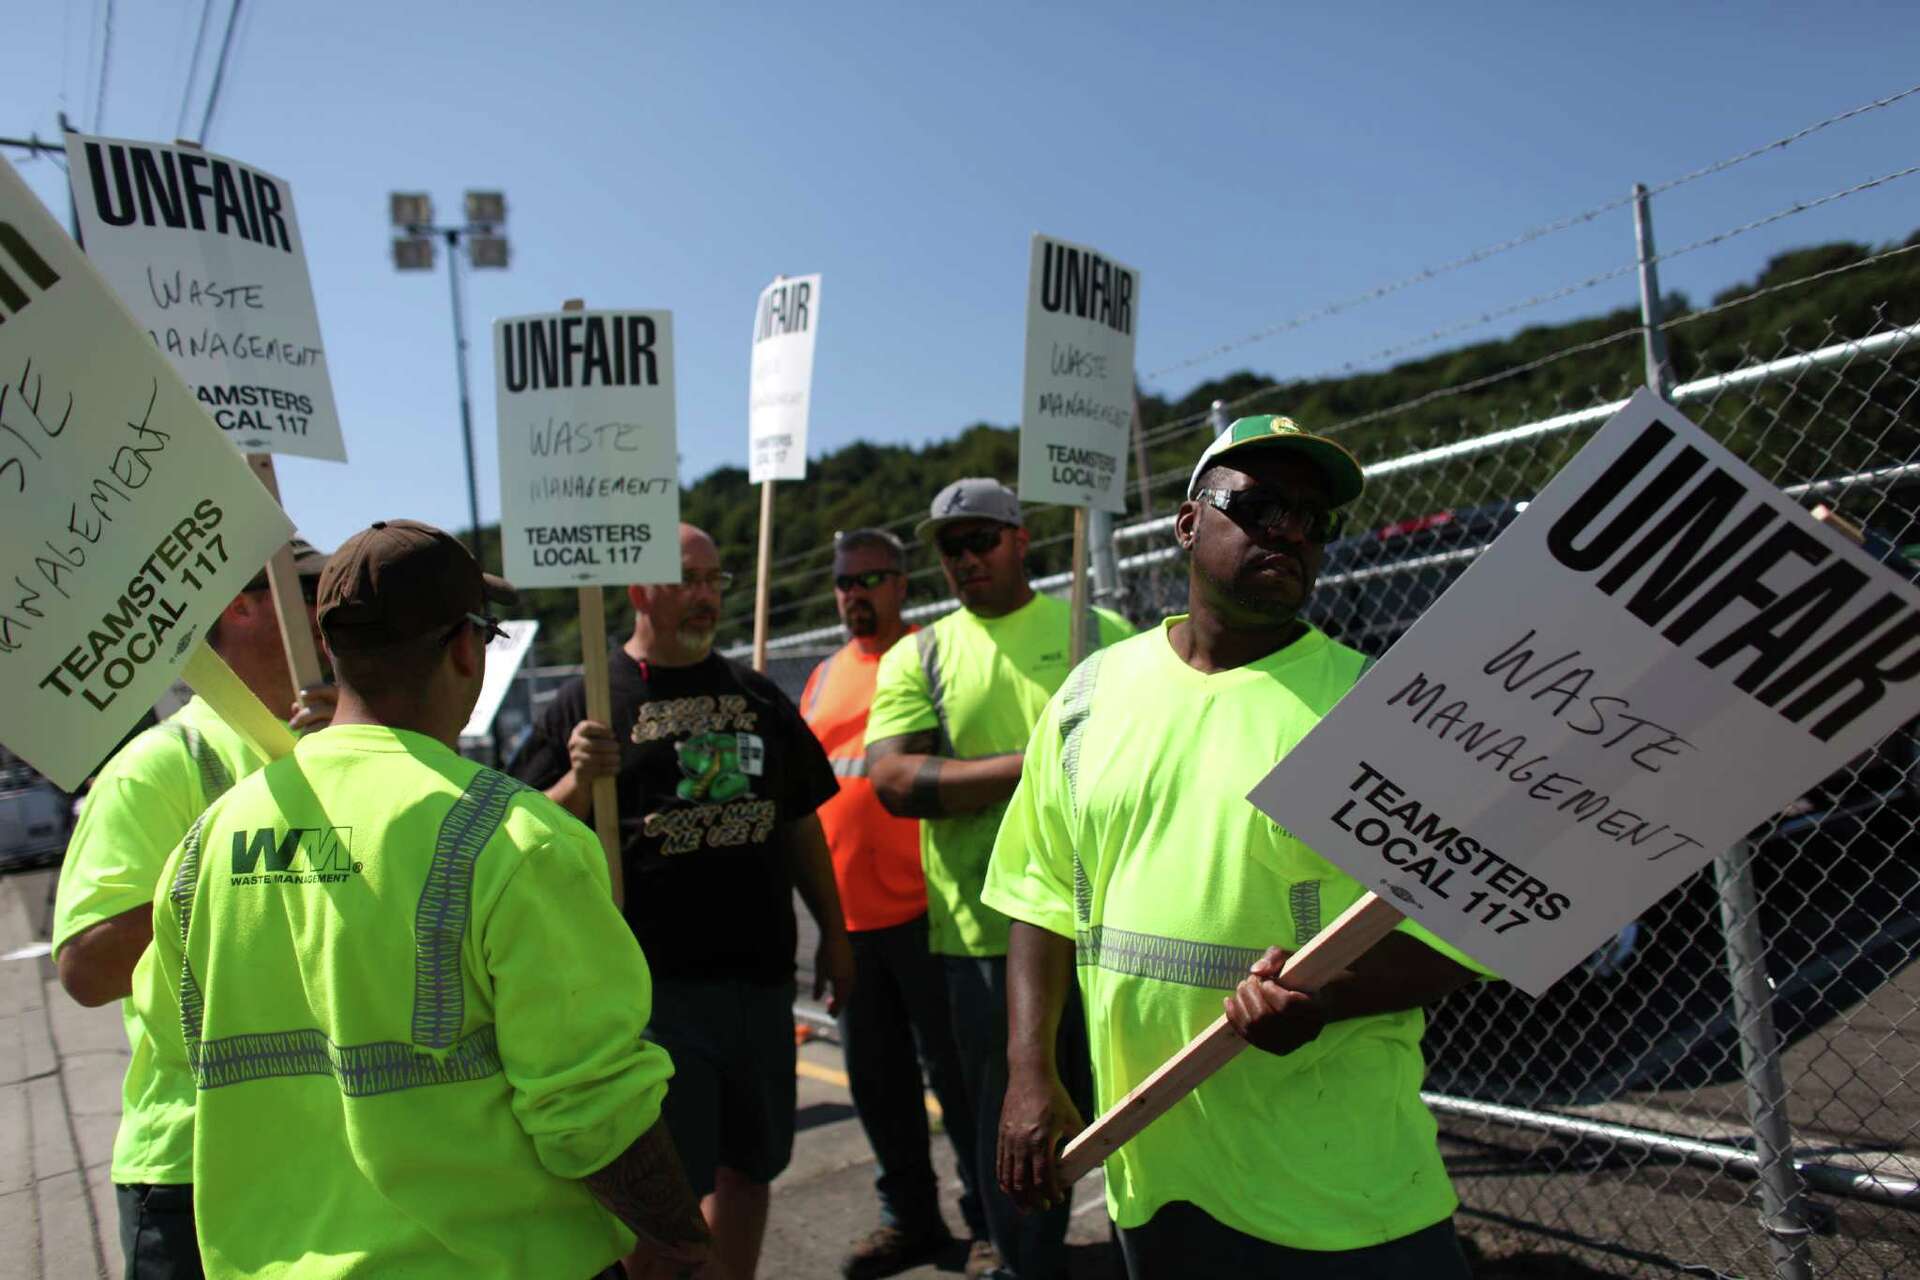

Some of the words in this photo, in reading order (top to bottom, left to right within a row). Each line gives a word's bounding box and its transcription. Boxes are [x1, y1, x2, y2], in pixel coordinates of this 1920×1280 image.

[84, 142, 292, 253] UNFAIR
[148, 266, 264, 310] WASTE
[1042, 242, 1133, 335] UNFAIR
[503, 316, 658, 392] UNFAIR
[1051, 342, 1108, 379] WASTE
[197, 385, 313, 415] AMSTERS
[215, 410, 272, 431] CAL
[276, 414, 309, 436] 117
[529, 417, 642, 457] WASTE
[1046, 444, 1117, 475] TEAMSTERS
[530, 475, 671, 503] MANAGEMENT
[1052, 466, 1096, 489] LOCAL
[0, 377, 170, 653] ANAGEMENT
[525, 524, 651, 545] TEAMSTERS
[533, 547, 600, 567] LOCAL
[609, 546, 642, 564] 117
[38, 499, 224, 697] TEAMSTERS
[1546, 418, 1920, 743] UNFAIR
[81, 597, 188, 712] LOCAL
[181, 534, 229, 591] 117
[1483, 629, 1702, 773] WASTE
[1387, 672, 1704, 862] MANAGEMENT
[232, 827, 352, 874] WM
[1347, 761, 1571, 922] TEAMSTERS
[231, 875, 272, 886] WASTE
[273, 874, 350, 884] MANAGEMENT
[1331, 800, 1452, 900] LOCAL
[1462, 891, 1531, 935] 117
